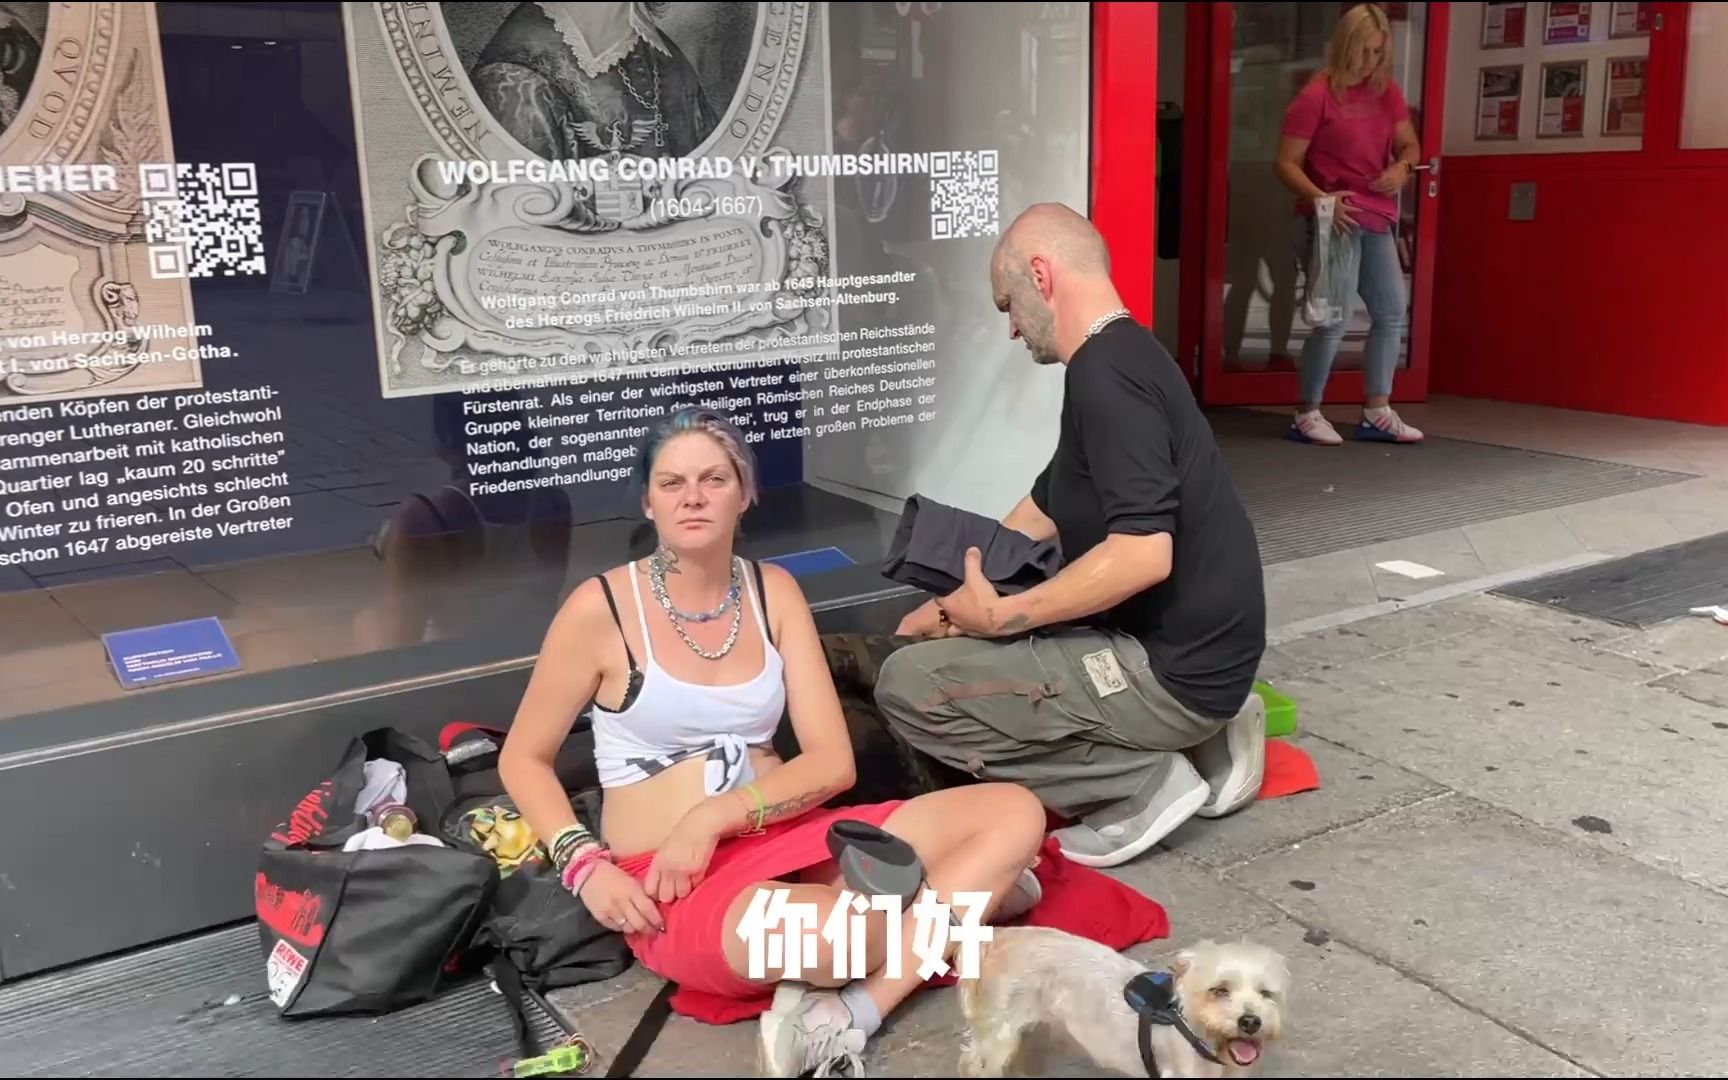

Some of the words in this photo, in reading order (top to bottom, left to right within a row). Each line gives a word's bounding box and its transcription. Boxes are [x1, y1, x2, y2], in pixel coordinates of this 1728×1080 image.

[0, 164, 118, 193] EHER
[437, 158, 609, 184] WOLFGANG
[618, 156, 733, 181] CONRAD
[740, 156, 762, 179] V.
[770, 153, 928, 178] THUMBSHIRN
[650, 196, 762, 221] (1604-1667)
[481, 292, 556, 309] Wolfgang
[560, 289, 616, 304] Conrad
[619, 290, 645, 301] von
[650, 281, 733, 299] Thumbshirn
[736, 283, 761, 294] war
[764, 280, 781, 292] ab
[784, 276, 814, 290] 1645
[816, 272, 916, 292] Hauptgesandter
[505, 315, 534, 329] des
[537, 311, 600, 328] Herzogs
[605, 306, 670, 323] Friedrich
[674, 302, 729, 318] Wilhelm
[750, 300, 772, 311] von
[775, 291, 900, 311] Sachsen-Altenburg.
[7, 334, 47, 349] von
[52, 328, 127, 346] Herzog
[132, 323, 213, 340] Wilhelm
[460, 360, 477, 374] Er
[480, 356, 537, 376] gehörte
[540, 356, 556, 367] zu
[559, 352, 586, 365] den
[589, 346, 666, 363] wichtigsten
[669, 340, 733, 356] Vertretern
[735, 338, 756, 351] der
[759, 330, 857, 351] protestantischen
[860, 323, 936, 341] Reichsstände
[31, 358, 69, 371] von
[74, 345, 239, 370] Sachsen-Gotha.
[650, 364, 679, 378] dem
[842, 341, 936, 361] protestantischen
[0, 405, 53, 422] nden
[60, 398, 130, 419] Köpfen
[136, 394, 168, 411] der
[175, 385, 279, 410] protestanti-
[463, 396, 544, 416] Fürstenrat.
[551, 392, 574, 408] Als
[580, 390, 615, 404] einer
[621, 386, 644, 400] der
[650, 380, 724, 398] wichtigsten
[729, 373, 784, 390] Vertreter
[788, 370, 819, 384] einer
[824, 359, 936, 380] überkonfessionellen
[465, 419, 522, 437] Gruppe
[528, 412, 590, 430] kleinerer
[596, 404, 665, 423] Territorien
[700, 395, 752, 411] Heiligen
[757, 387, 824, 405] Römischen
[829, 381, 875, 398] Reiches
[880, 375, 936, 392] Deutscher
[70, 418, 178, 441] Lutheraner.
[183, 406, 282, 429] Gleichwohl
[466, 439, 520, 457] Nation,
[528, 435, 553, 450] der
[763, 409, 788, 424] trug
[795, 409, 807, 420] er
[813, 404, 825, 417] in
[831, 403, 850, 416] der
[856, 396, 912, 413] Endphase
[918, 393, 936, 406] der
[0, 443, 129, 471] ammenarbeit
[135, 438, 165, 456] mit
[171, 430, 284, 454] katholischen
[467, 453, 577, 477] Verhandlungen
[583, 444, 638, 463] maßgeb
[745, 430, 766, 444] der
[771, 425, 811, 441] letzten
[816, 420, 856, 438] großen
[861, 413, 914, 430] Probleme
[918, 410, 936, 423] der
[79, 470, 108, 487] lag
[182, 460, 205, 475] 20
[6, 500, 54, 517] Ofen
[62, 493, 99, 511] und
[107, 482, 208, 508] angesichts
[214, 471, 289, 494] schlecht
[0, 522, 62, 542] Winter
[68, 519, 91, 534] zu
[96, 510, 163, 530] frieren.
[169, 506, 186, 521] In
[191, 500, 221, 519] der
[227, 494, 291, 514] Großen
[0, 547, 59, 566] schon
[64, 537, 109, 557] 1647
[115, 526, 213, 551] abgereiste
[217, 515, 294, 537] Vertreter
